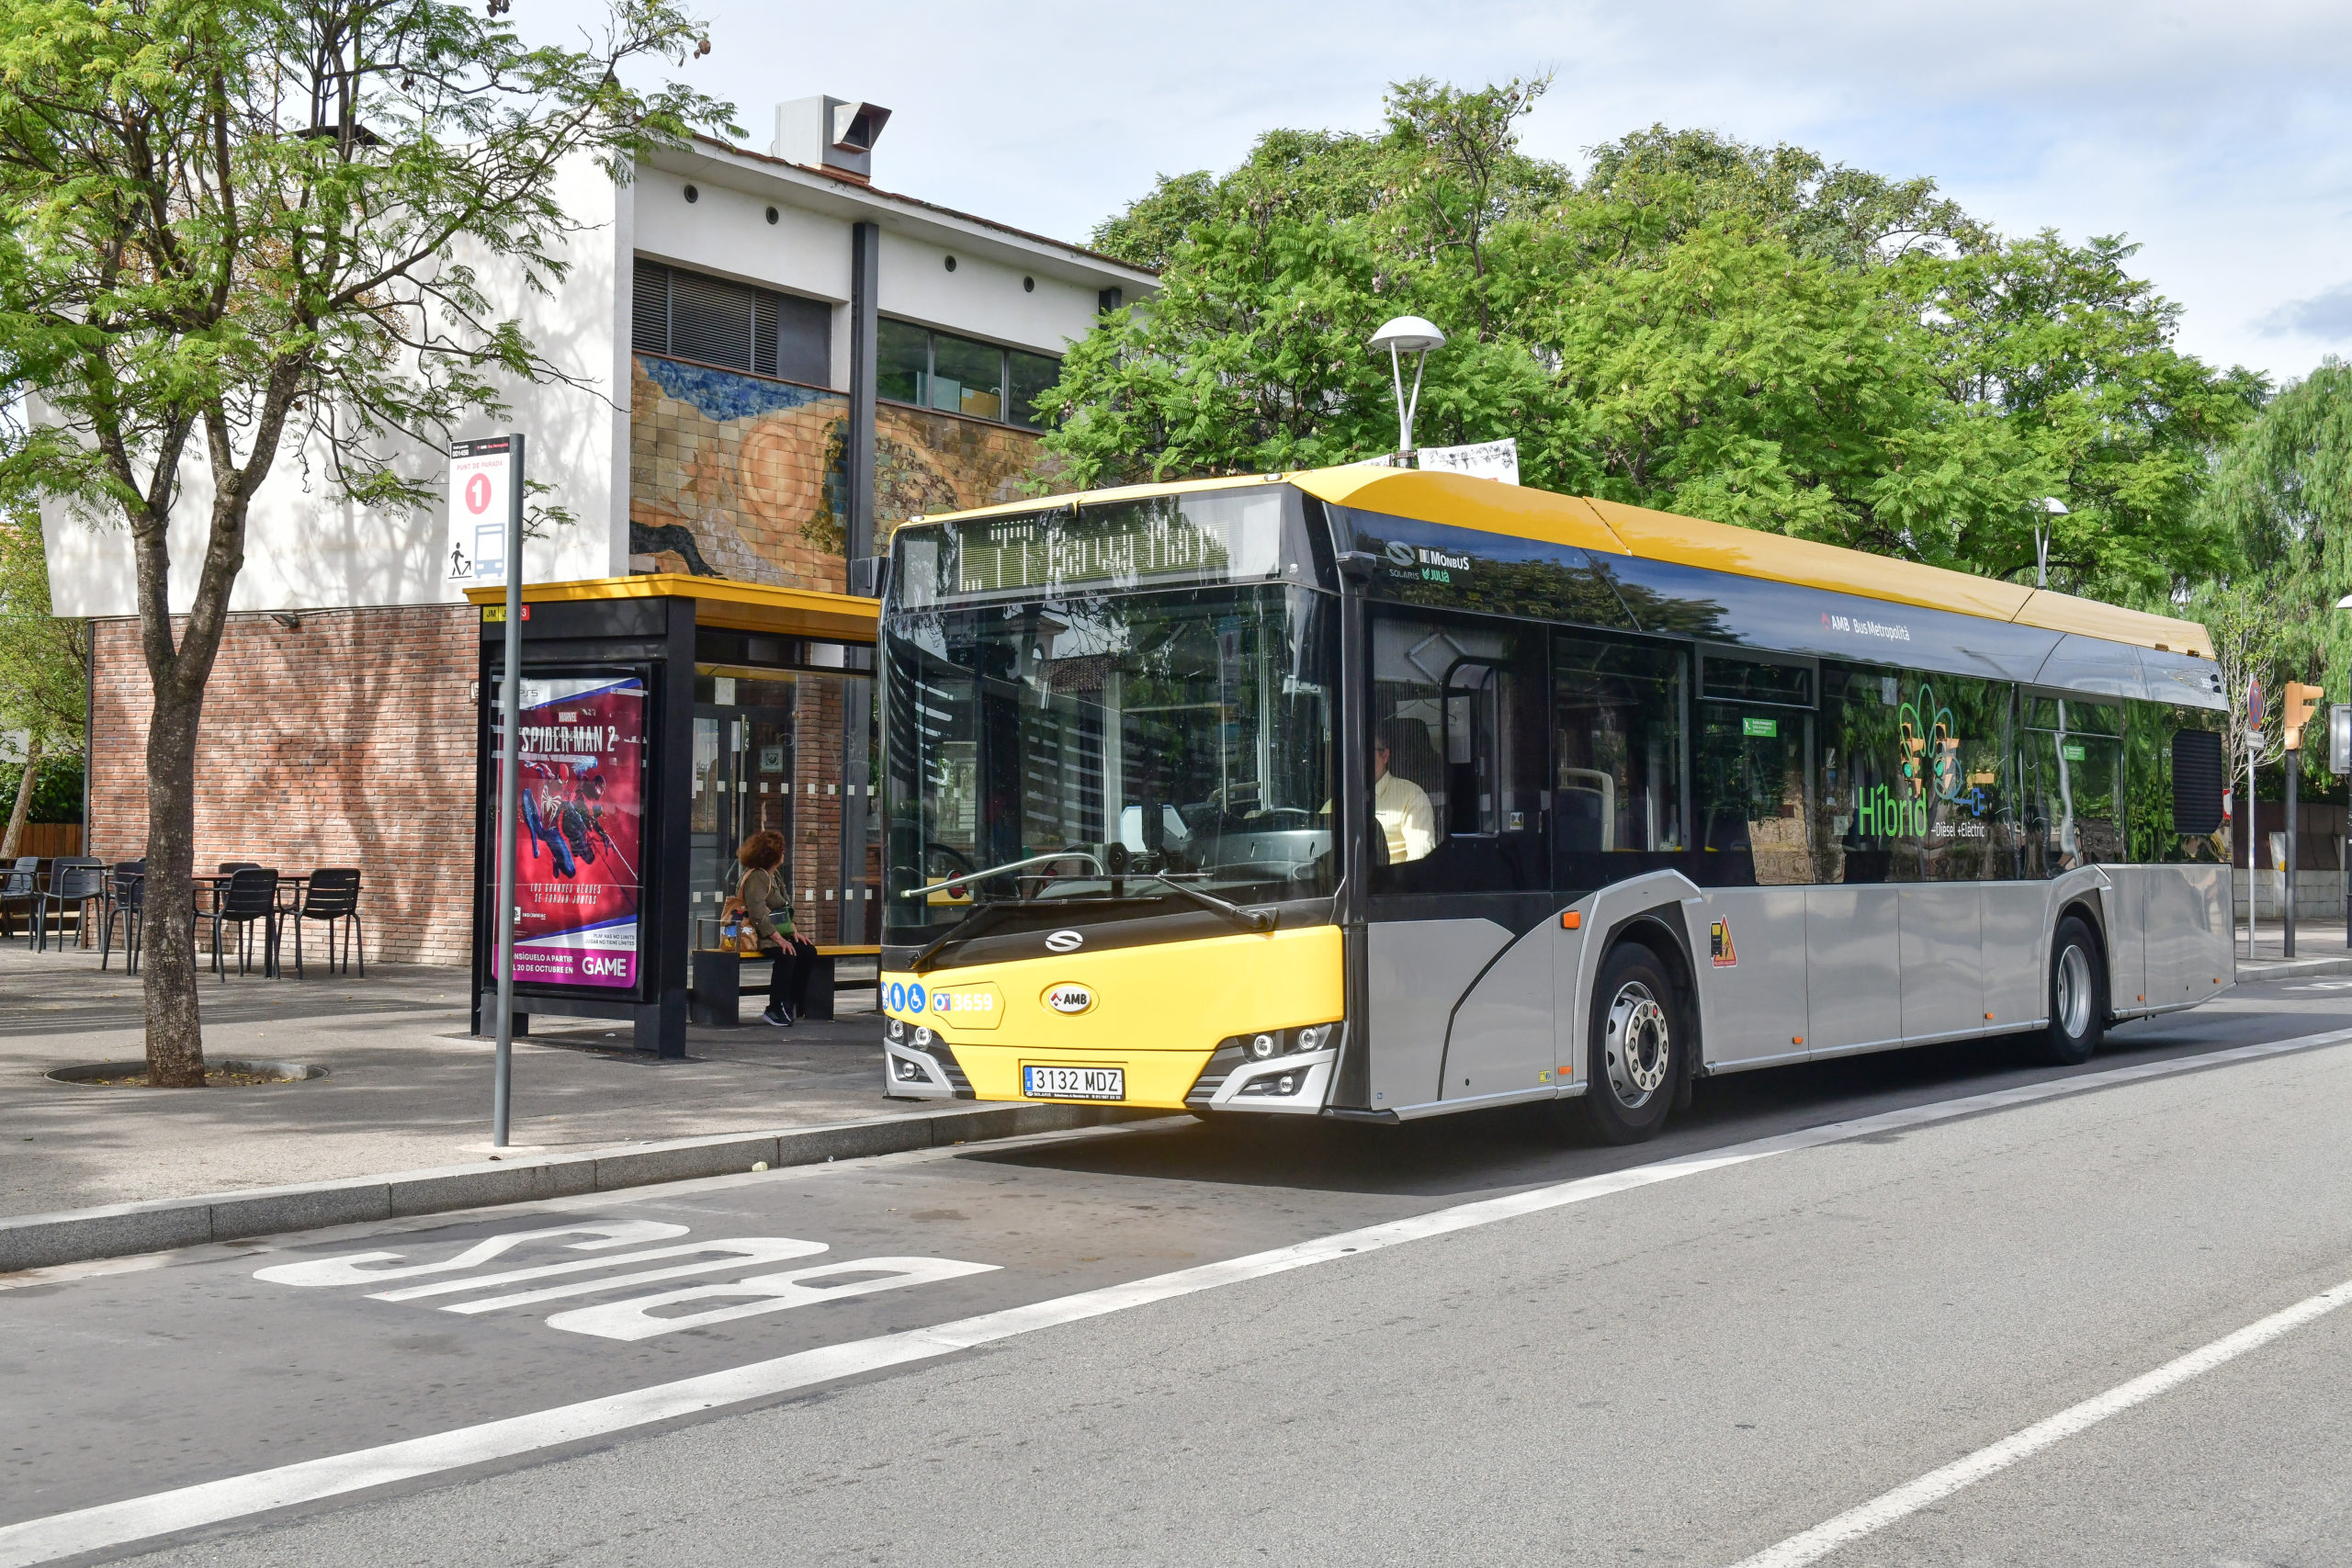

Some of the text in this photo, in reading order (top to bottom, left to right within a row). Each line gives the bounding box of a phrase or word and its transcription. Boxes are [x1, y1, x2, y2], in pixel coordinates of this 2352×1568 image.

[472, 479, 482, 507] 1
[1390, 570, 1419, 580] SOLARIS
[1831, 615, 1910, 641] AMB Bus Metropolità
[519, 689, 538, 697] PS5
[559, 712, 577, 722] MARVEL
[521, 726, 616, 753] SPIDER-MAN 2
[1859, 783, 1928, 837] Híbrid
[530, 883, 542, 892] LOS
[545, 883, 573, 894] GRANDES
[534, 894, 597, 904] SE FORJAN JUNTOS
[513, 952, 545, 962] NSÍGUELO
[535, 965, 564, 973] OCTUBRE
[582, 957, 626, 977] GAME
[953, 993, 1087, 1011] 3659 AMB
[1036, 1070, 1118, 1092] 3132 MDZ
[253, 1219, 1004, 1342] BUS
